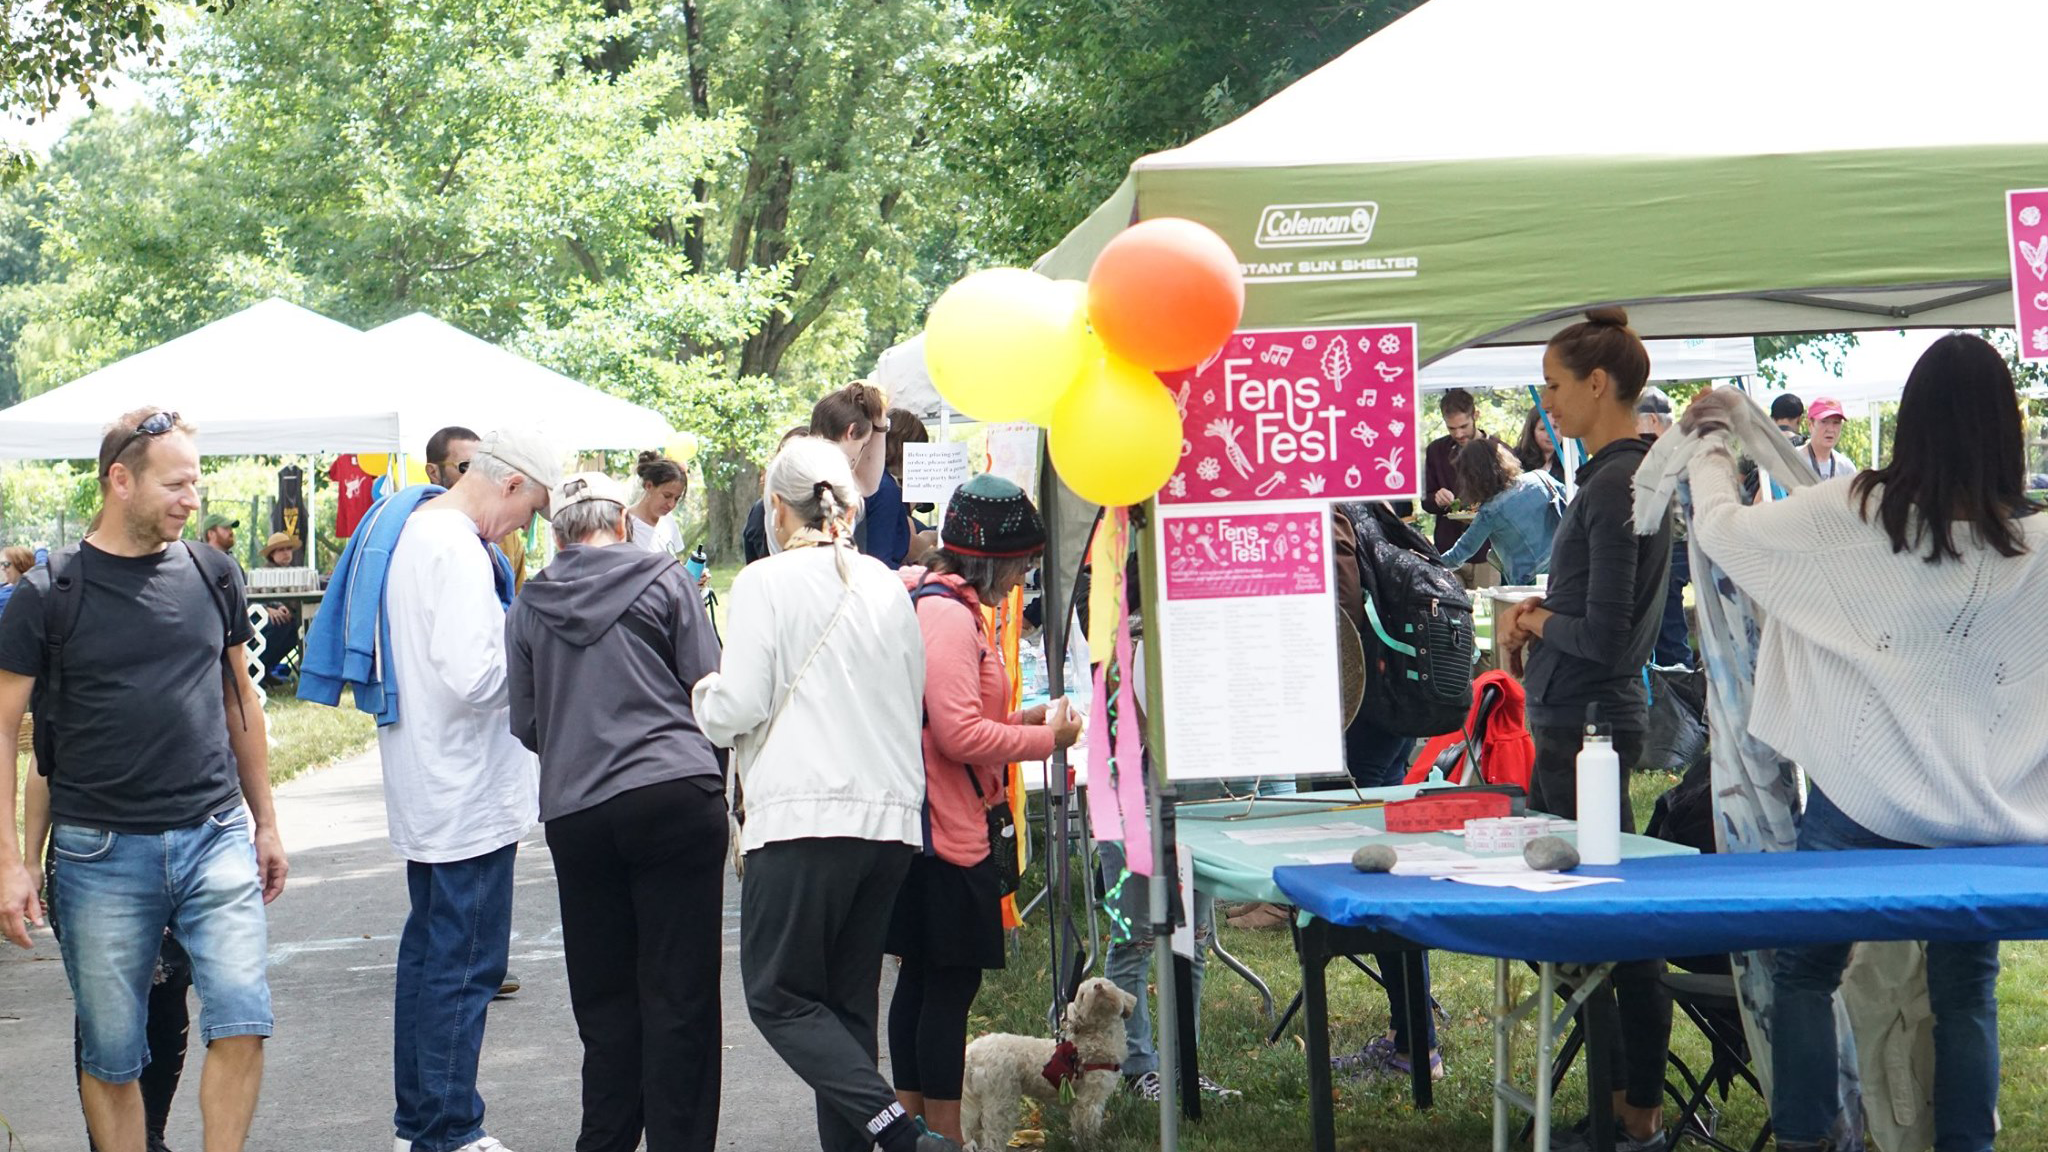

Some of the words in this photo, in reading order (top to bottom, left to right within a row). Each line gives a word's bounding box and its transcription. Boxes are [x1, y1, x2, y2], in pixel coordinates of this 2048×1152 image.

[1266, 210, 1351, 237] Coleman
[1239, 262, 1293, 275] STANT
[1298, 260, 1337, 273] SUN
[1341, 256, 1419, 271] SHELTER
[1224, 358, 1320, 432] Fens
[1256, 405, 1346, 464] Fest
[1218, 518, 1259, 549] Fens
[1231, 538, 1270, 563] Fest
[866, 1109, 894, 1135] MOUR
